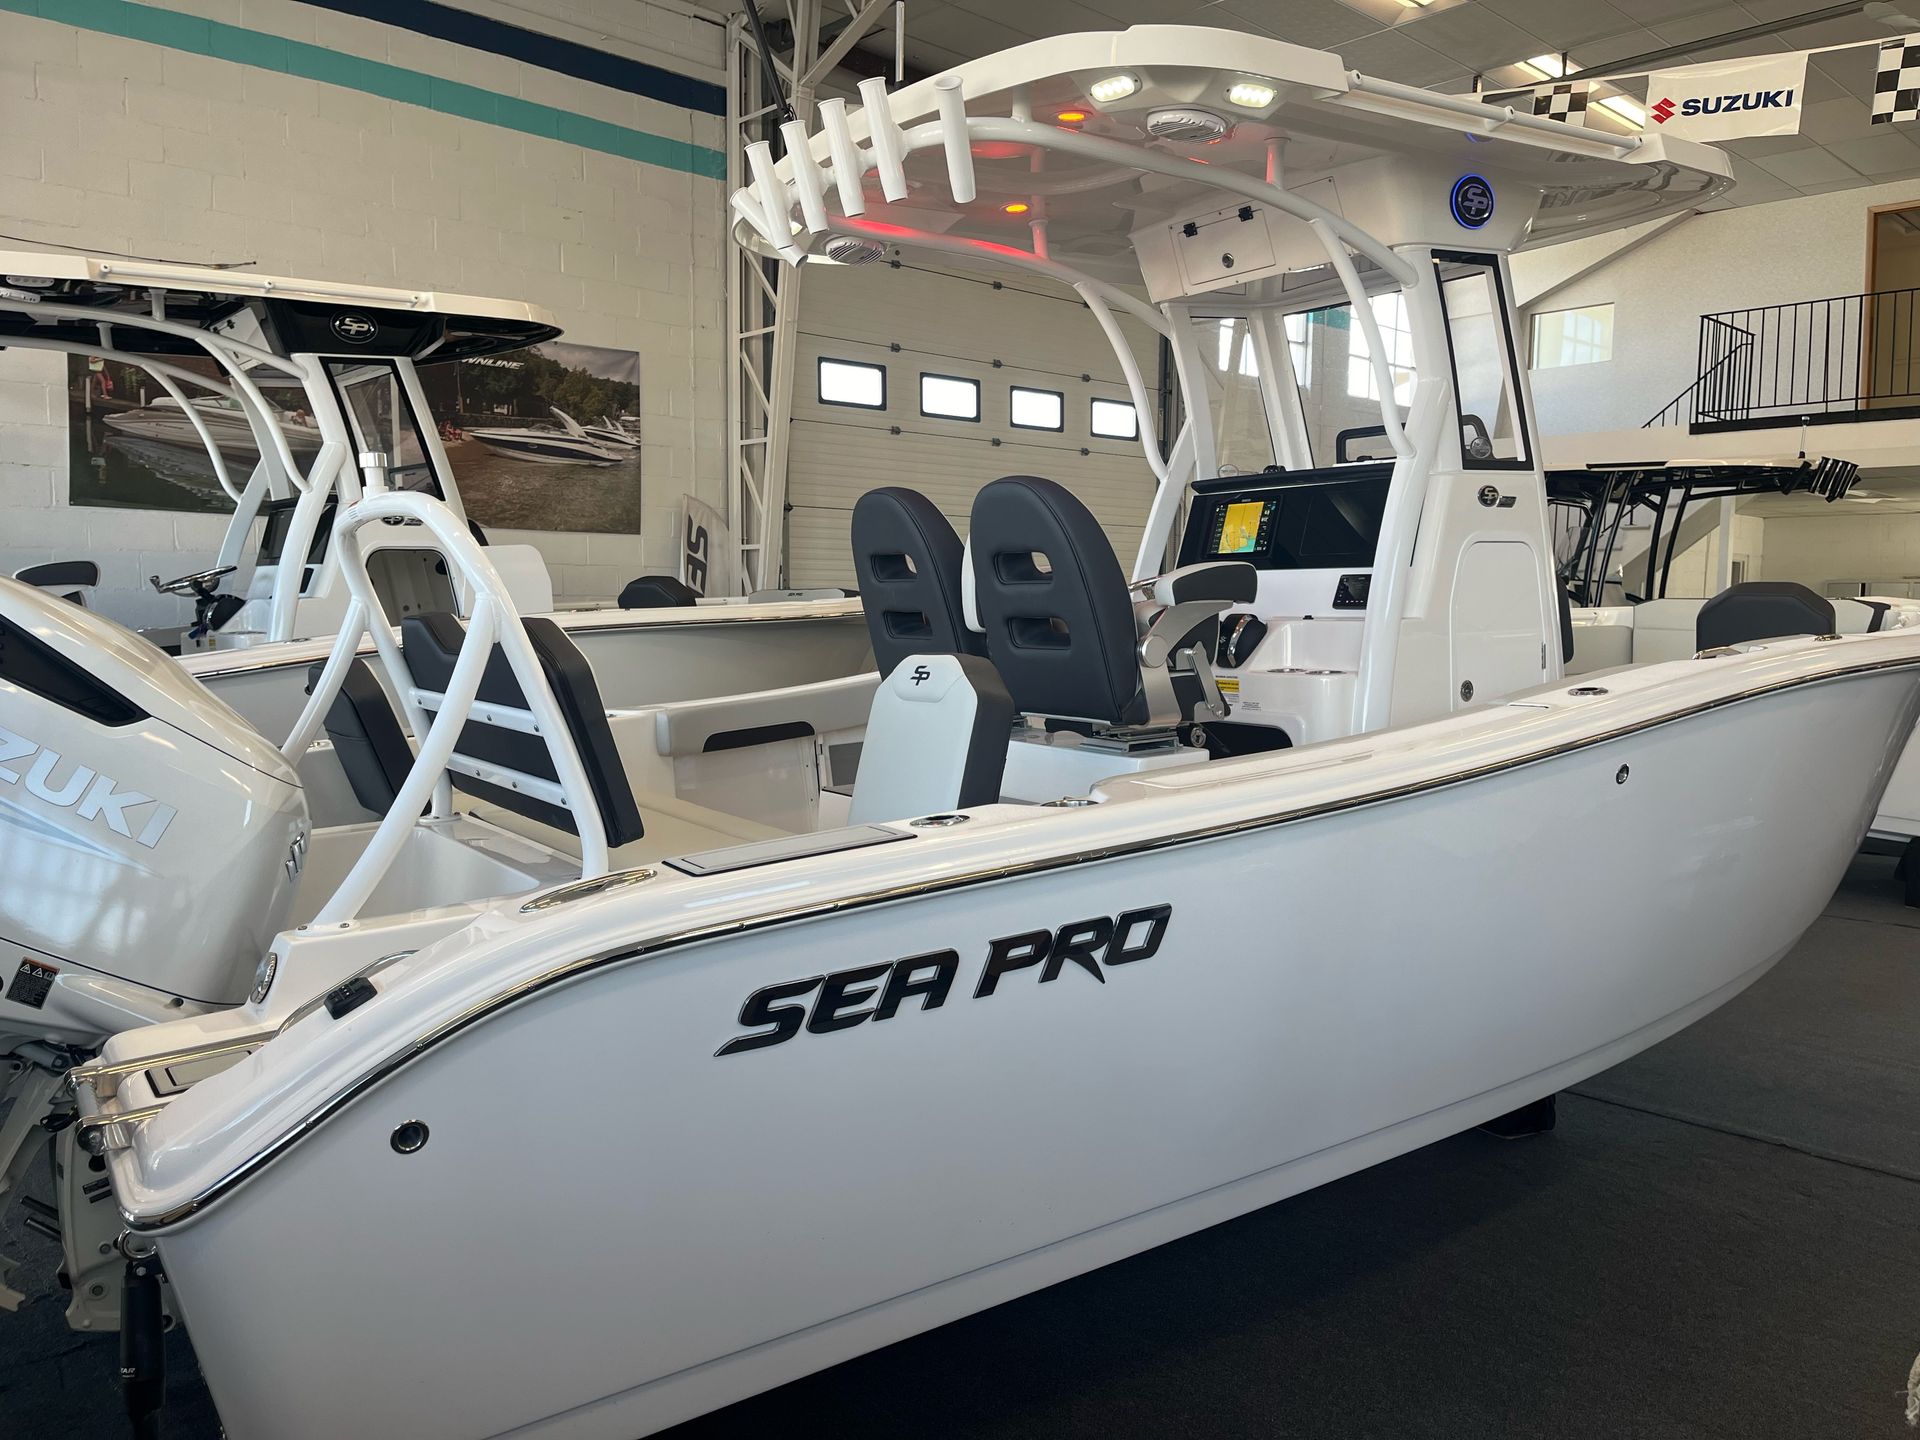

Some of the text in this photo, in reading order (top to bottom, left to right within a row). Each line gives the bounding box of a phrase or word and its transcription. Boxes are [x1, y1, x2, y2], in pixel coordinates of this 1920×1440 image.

[1681, 89, 1794, 117] SUZUKI
[713, 903, 1173, 1057] SEA PRO
